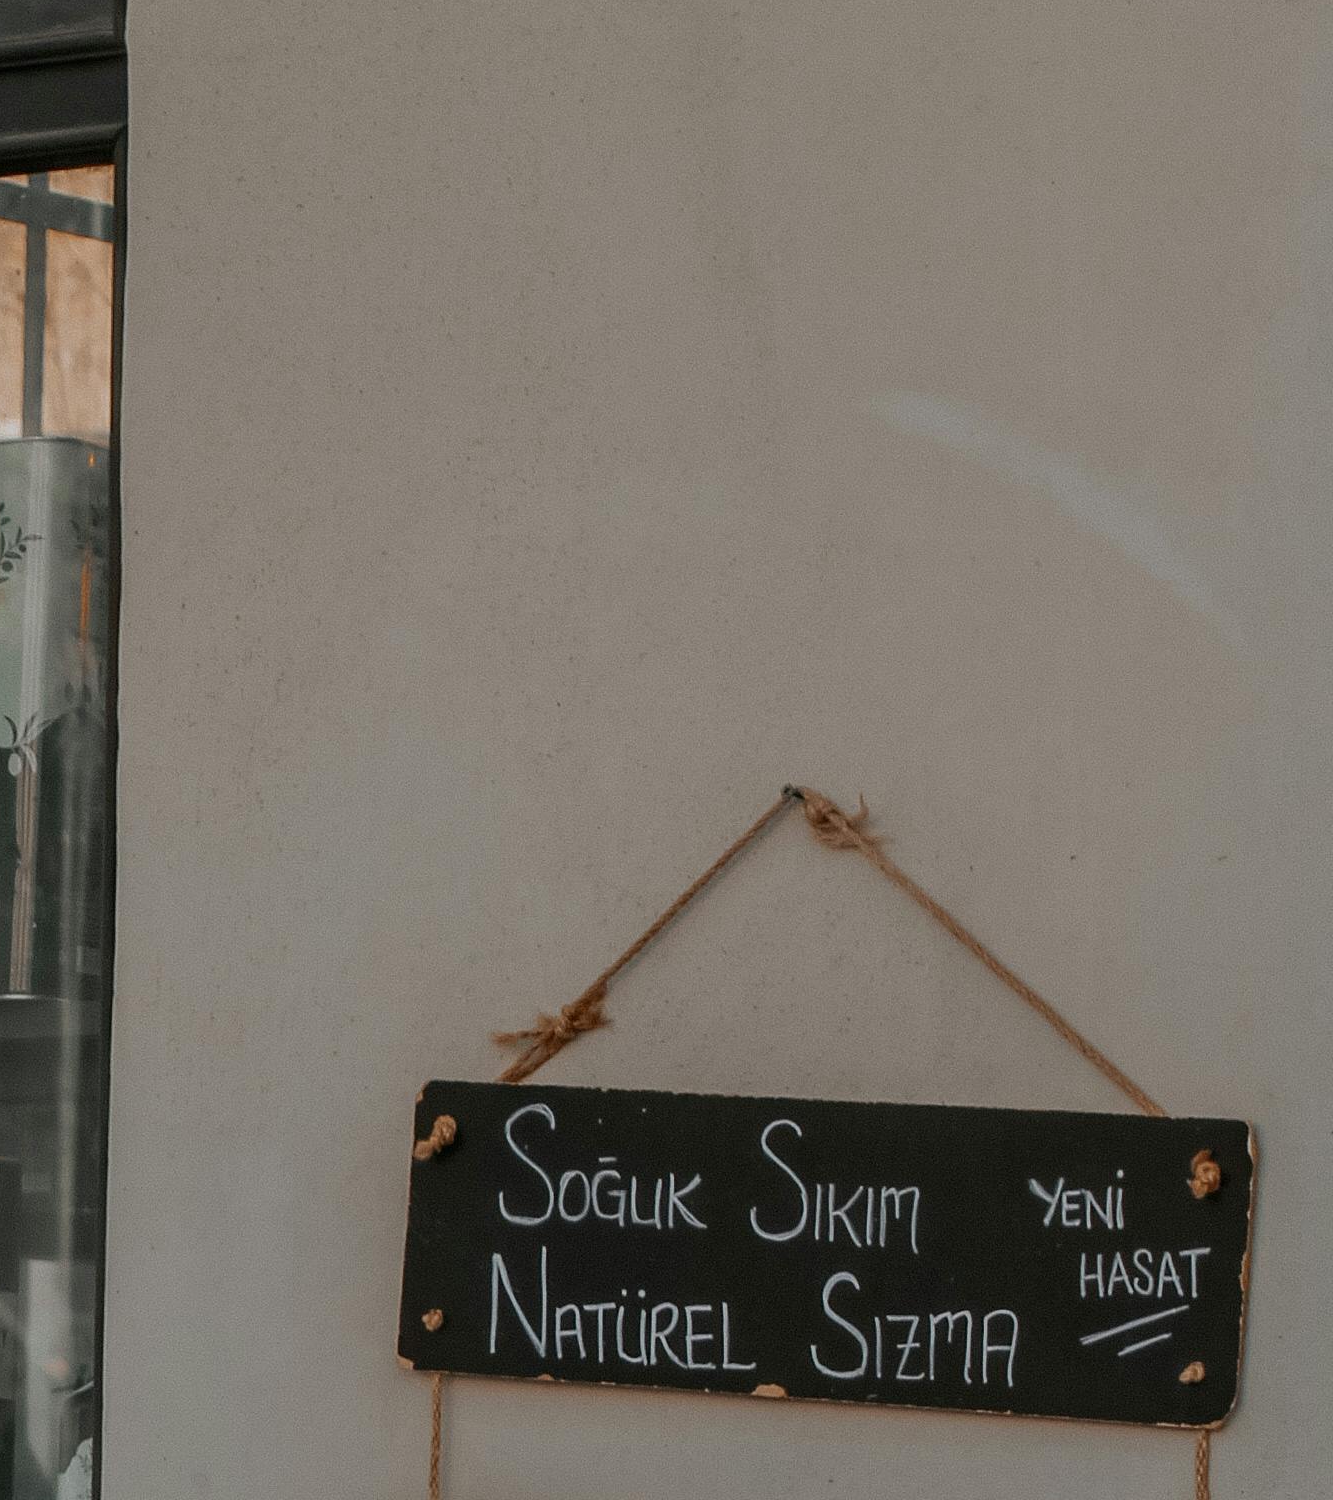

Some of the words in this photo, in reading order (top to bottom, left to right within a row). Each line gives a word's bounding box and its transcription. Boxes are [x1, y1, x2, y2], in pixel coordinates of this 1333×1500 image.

[1029, 1169, 1125, 1230] YENİ
[1080, 1247, 1211, 1300] HASAT
[489, 1246, 755, 1369] NATÜREL
